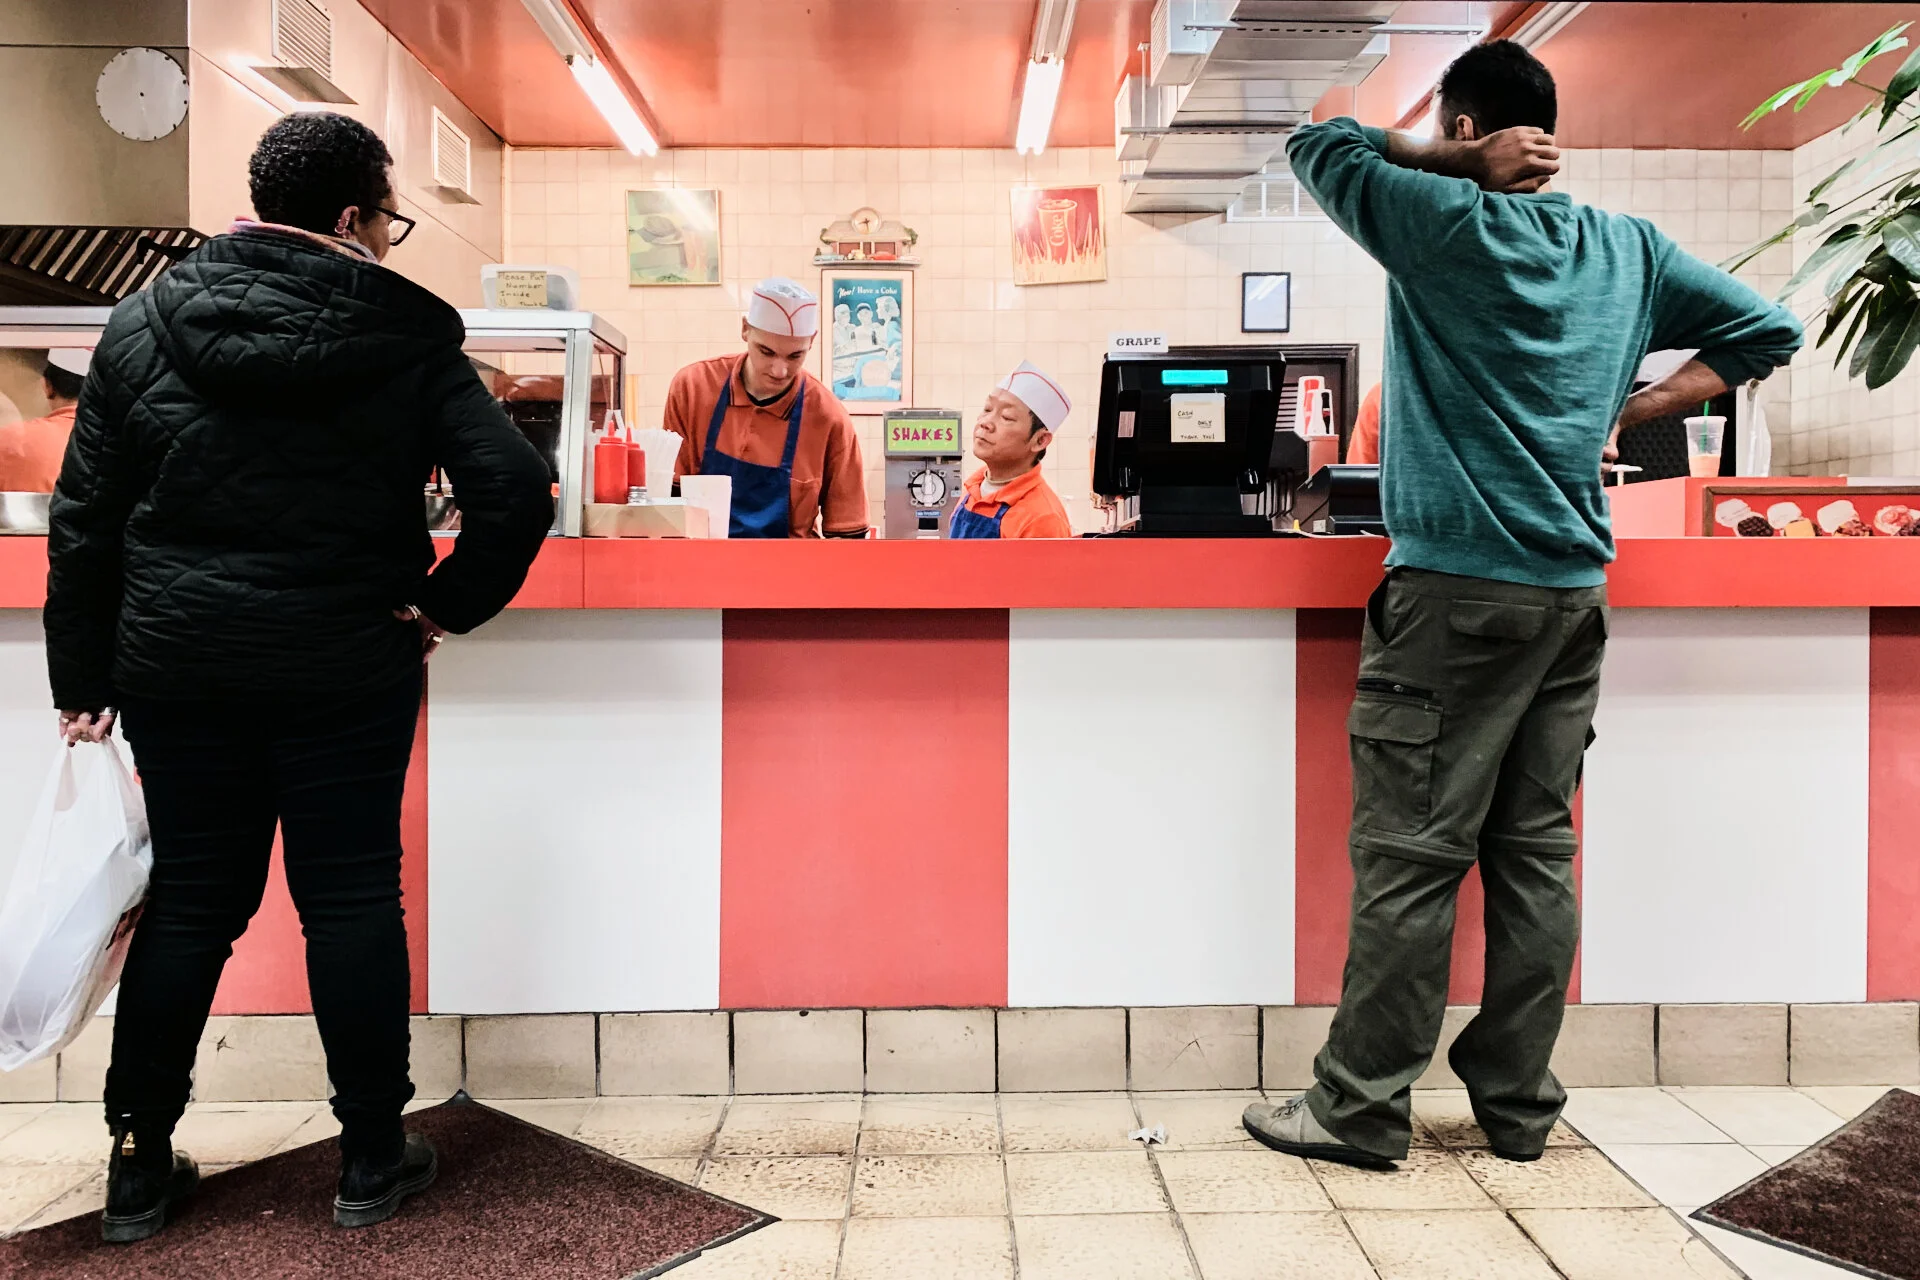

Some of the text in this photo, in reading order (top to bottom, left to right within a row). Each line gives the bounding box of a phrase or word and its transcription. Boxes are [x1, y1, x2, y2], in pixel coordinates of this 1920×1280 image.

[1050, 214, 1065, 246] Coke
[857, 286, 874, 294] Have
[880, 286, 898, 295] Coke
[1116, 337, 1161, 346] GRAPE
[892, 427, 953, 441] SHAKES
